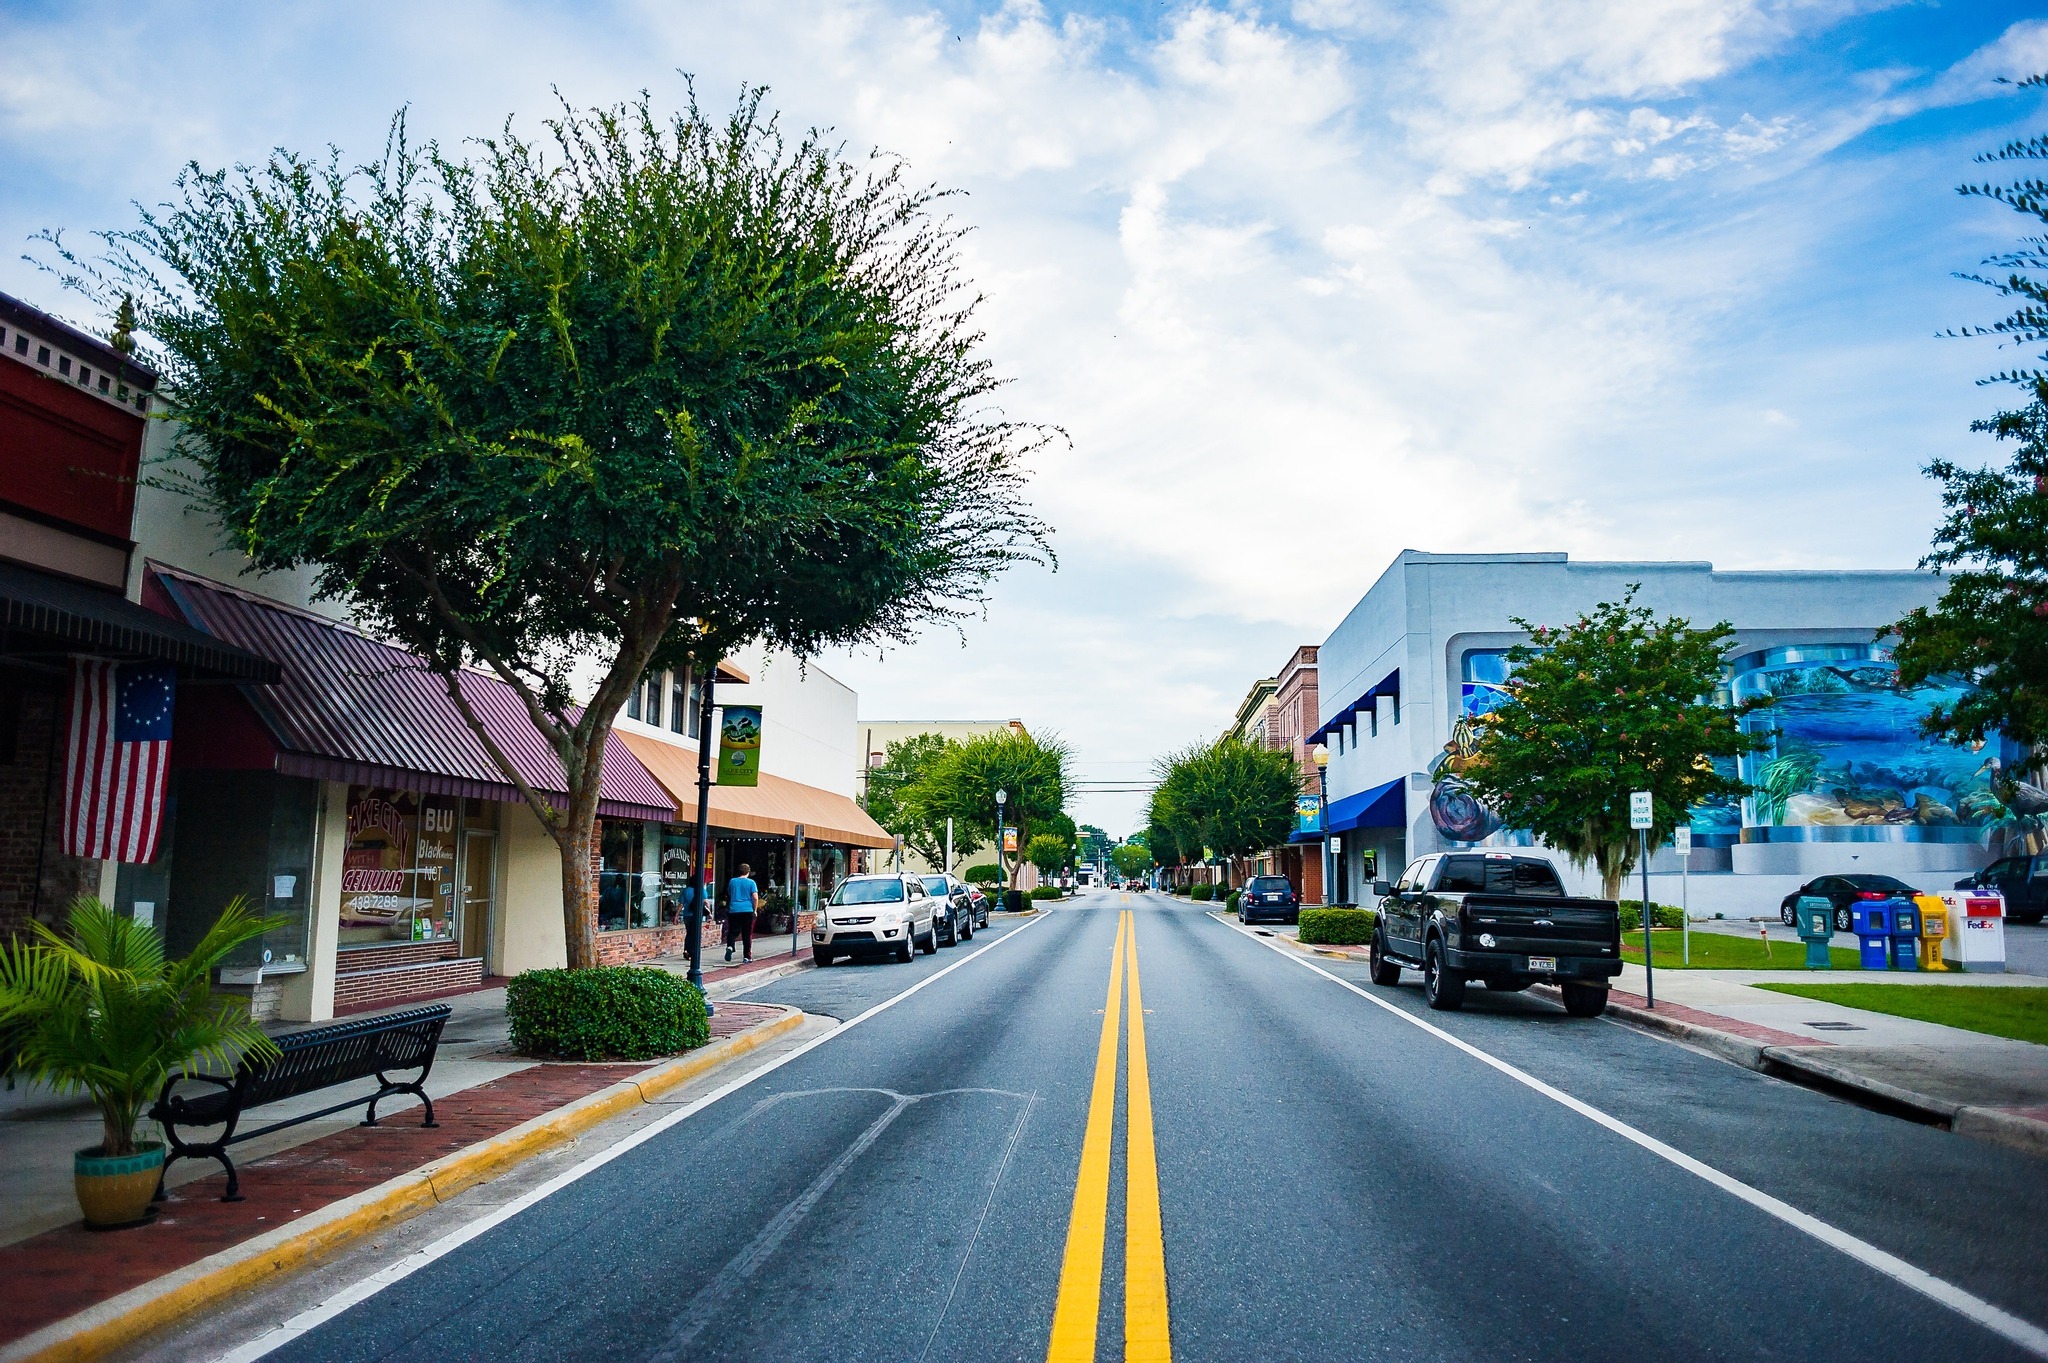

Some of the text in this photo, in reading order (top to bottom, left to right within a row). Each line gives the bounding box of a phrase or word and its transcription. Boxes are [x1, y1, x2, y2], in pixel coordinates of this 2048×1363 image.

[425, 808, 453, 833] BLU
[344, 799, 409, 871] AKE CITY
[419, 839, 442, 859] Black
[342, 870, 404, 892] CELLULAR
[665, 871, 676, 879] Mini
[1941, 897, 1957, 906] FedEx
[1967, 920, 1994, 929] FedEx
